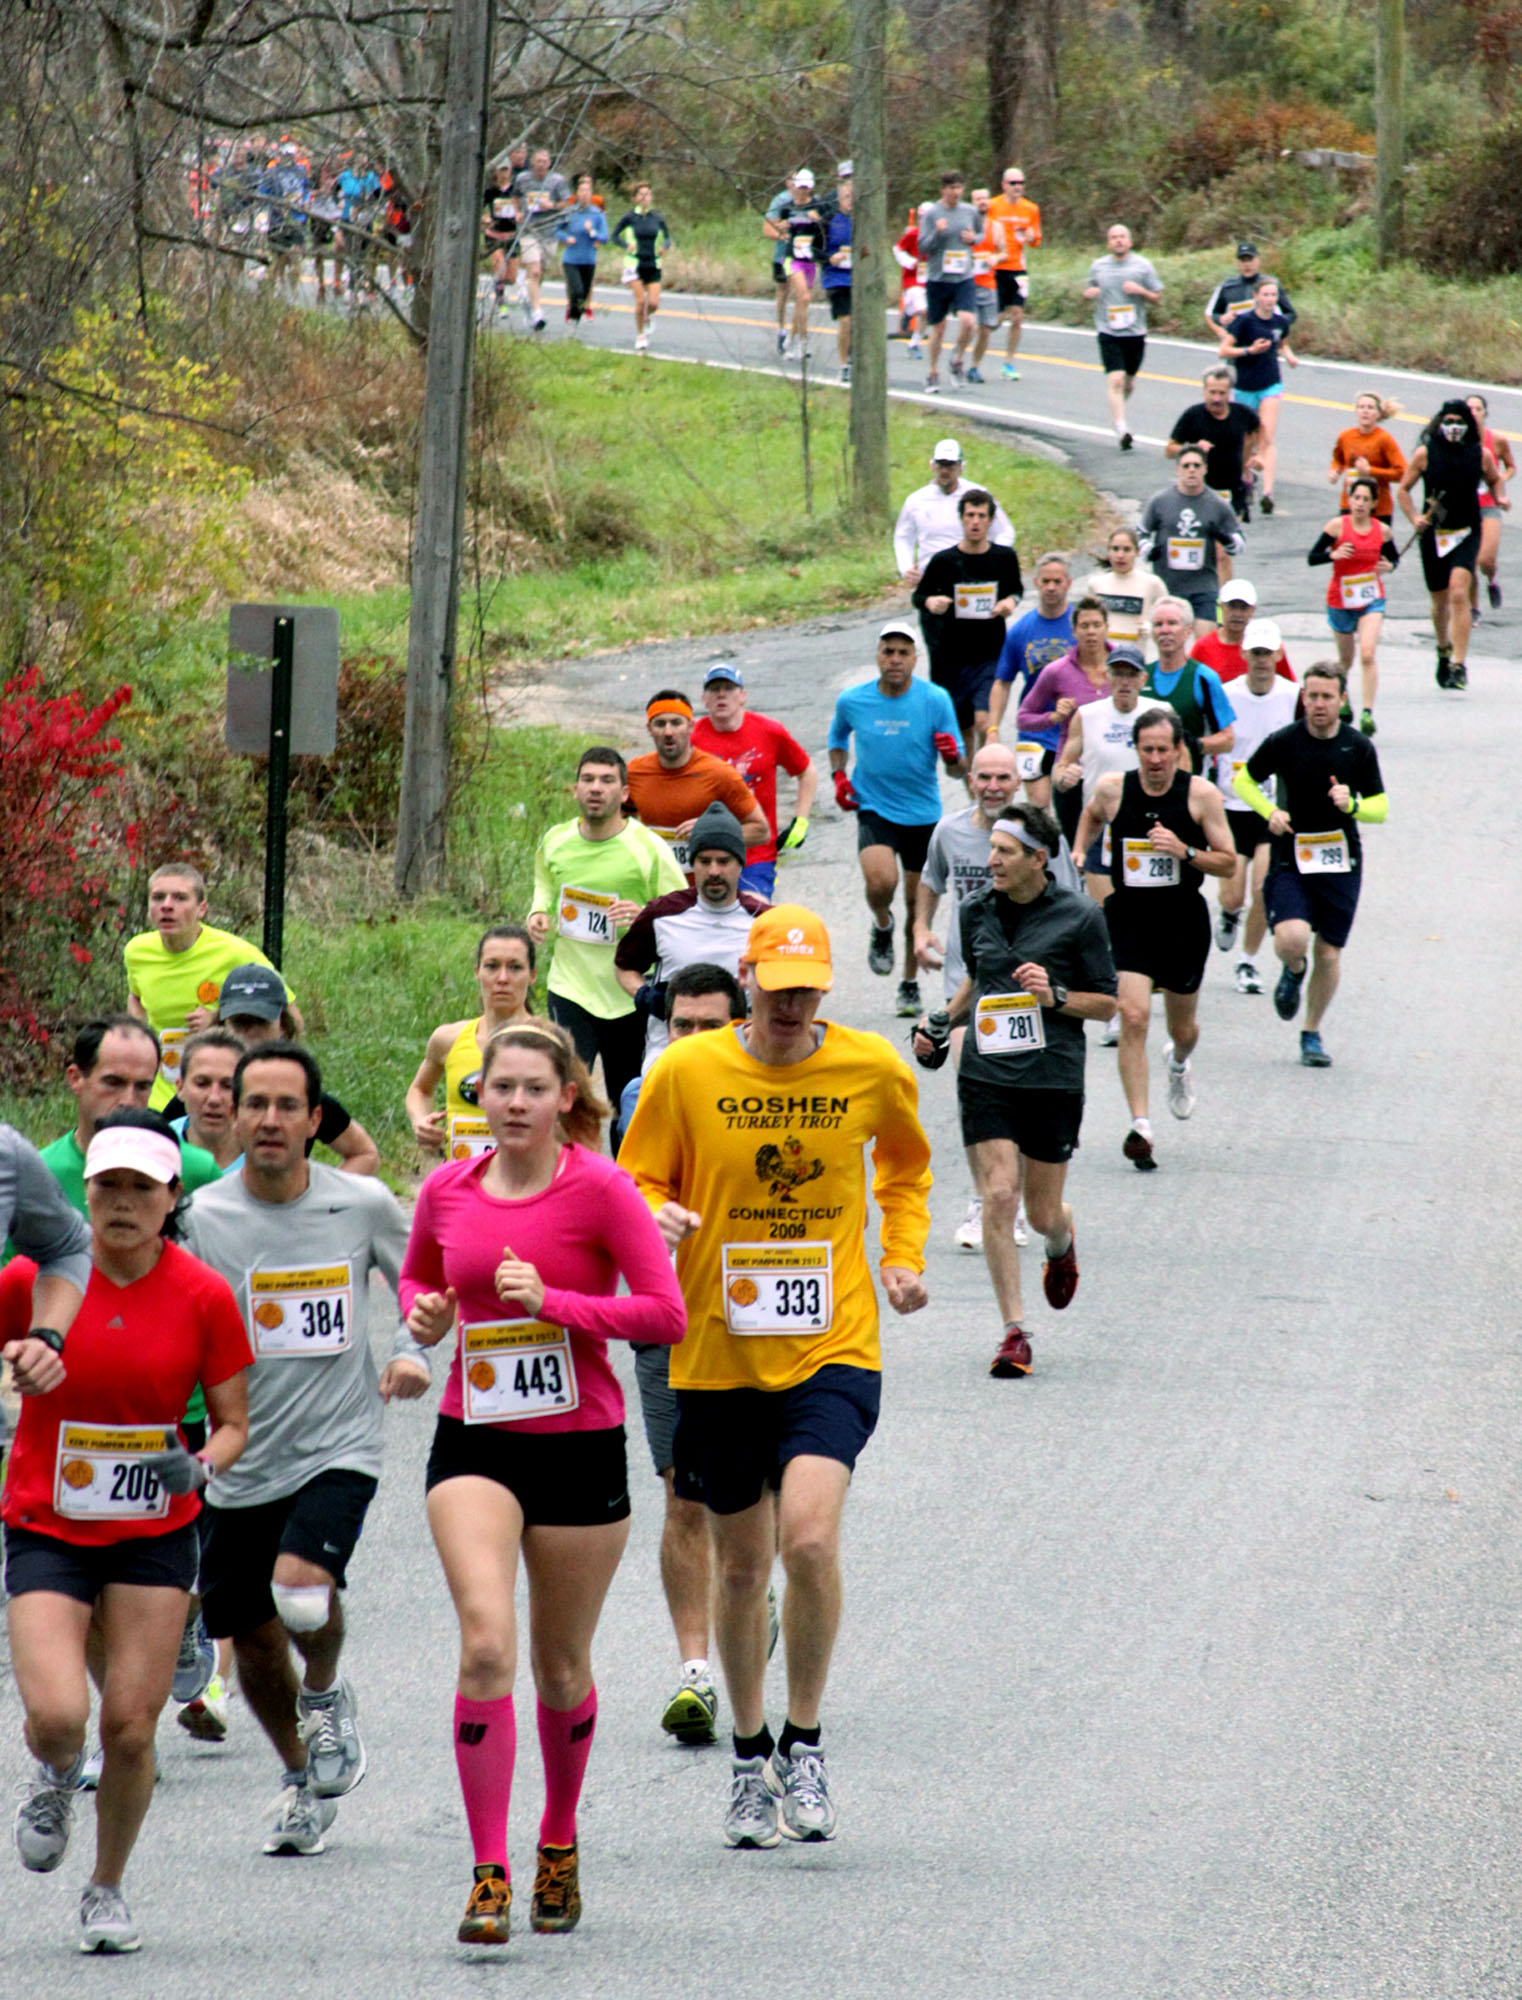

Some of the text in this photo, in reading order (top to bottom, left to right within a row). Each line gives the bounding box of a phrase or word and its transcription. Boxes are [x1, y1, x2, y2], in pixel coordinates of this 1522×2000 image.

[673, 846, 690, 864] 18
[1320, 847, 1342, 865] 299
[953, 865, 993, 878] RAIDE
[1149, 857, 1174, 877] 288
[588, 911, 607, 934] 124
[776, 944, 814, 955] TIMEX
[1007, 1015, 1034, 1039] 281
[717, 1097, 849, 1114] GOSHEN
[726, 1115, 843, 1129] TURKEY TROT
[728, 1205, 844, 1220] CONNECTICUT
[769, 1222, 807, 1239] 2009
[775, 1278, 820, 1317] 333
[300, 1298, 346, 1338] 384
[513, 1355, 563, 1398] 443
[109, 1463, 160, 1502] 206
